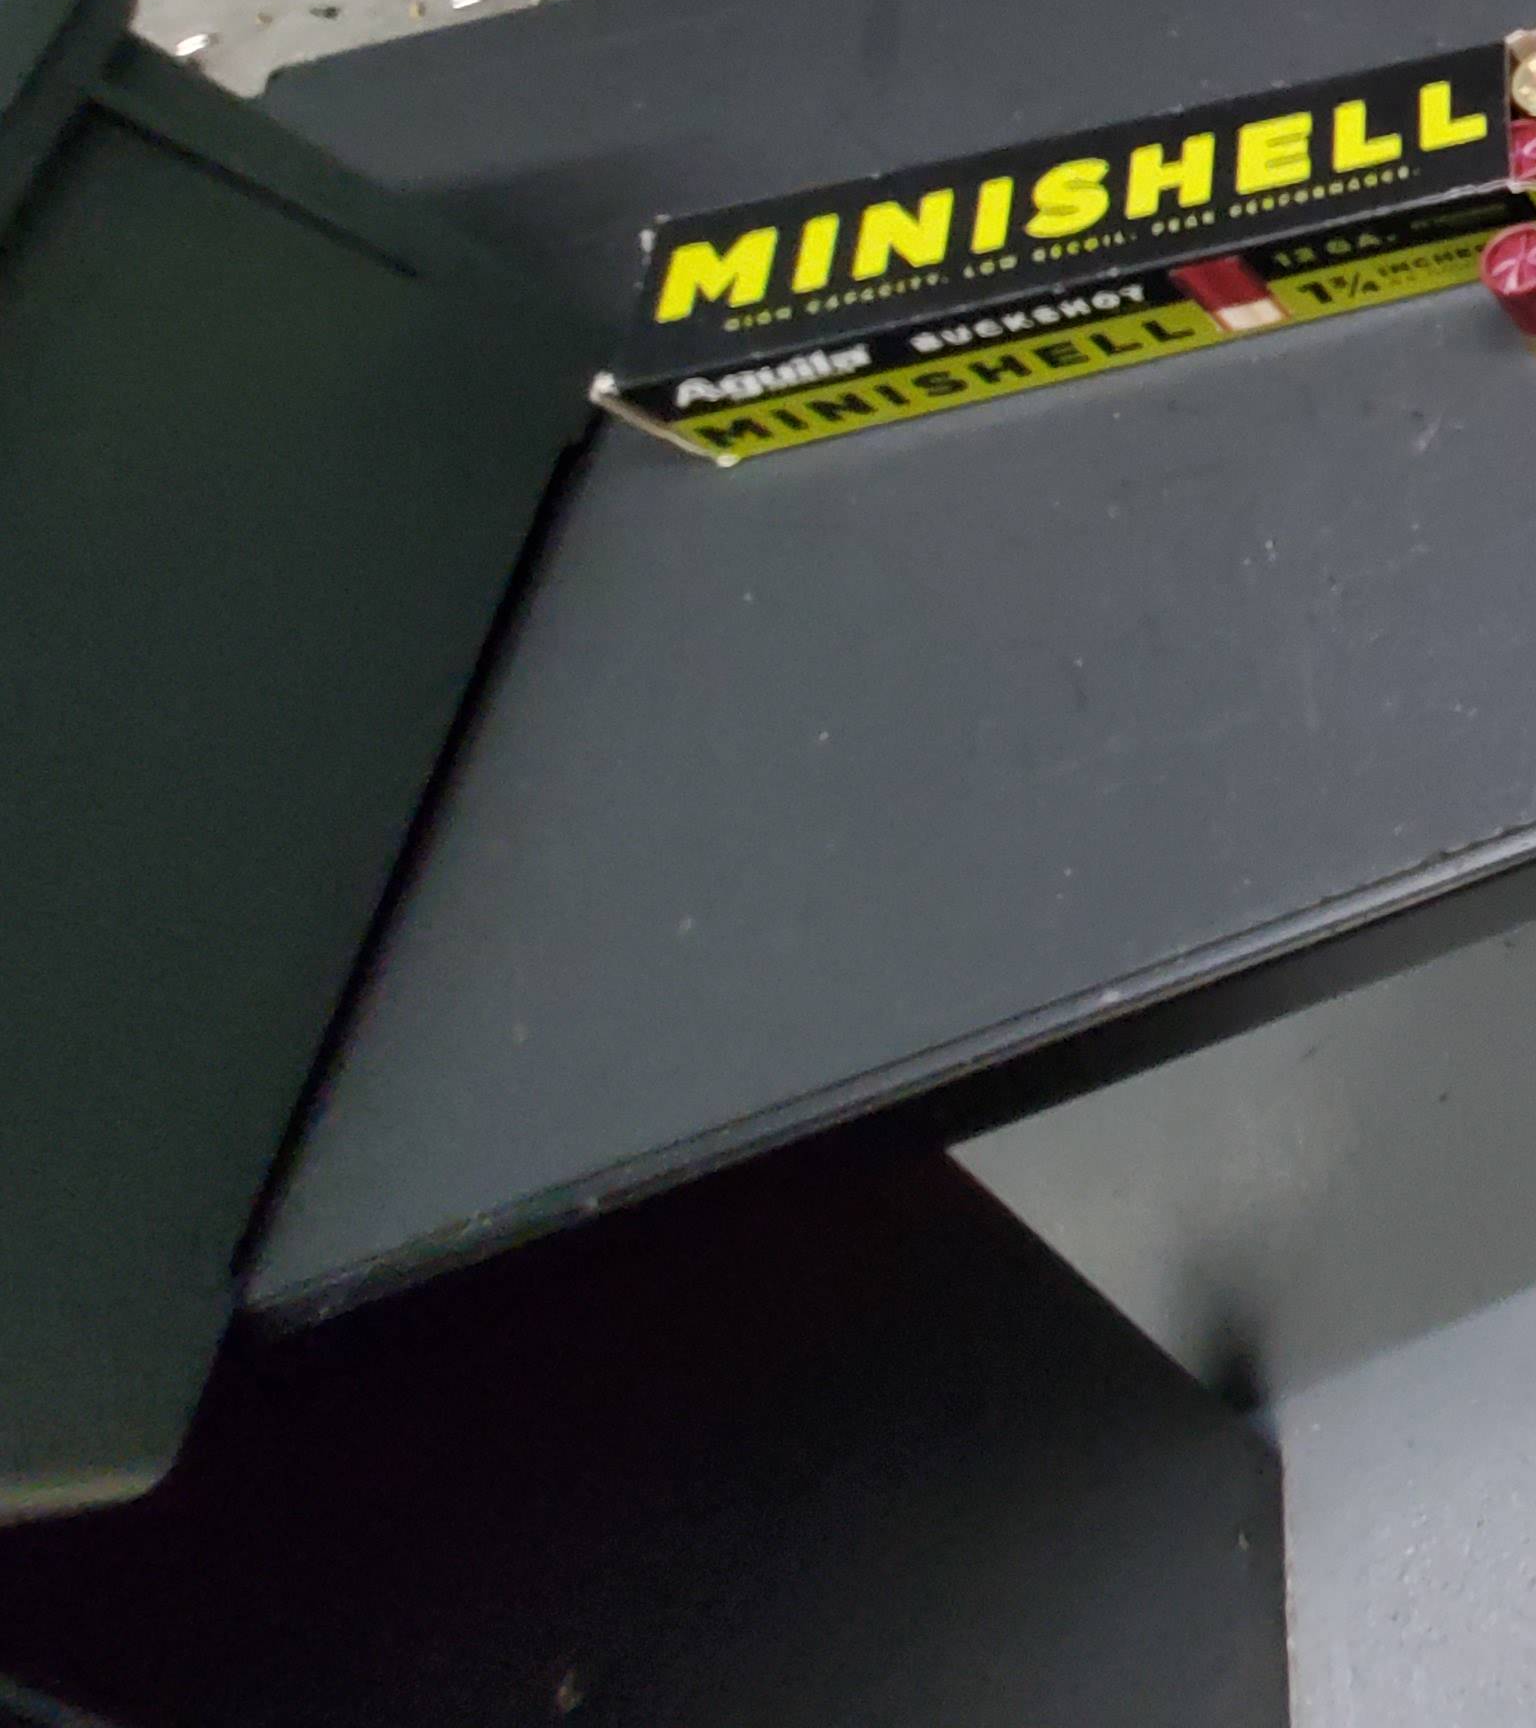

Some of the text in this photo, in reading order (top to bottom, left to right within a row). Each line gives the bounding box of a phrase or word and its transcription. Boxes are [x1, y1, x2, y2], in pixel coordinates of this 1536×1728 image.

[655, 80, 1488, 323] MINISHELL
[675, 283, 1145, 409] Aguila BUCKSHOT
[693, 318, 1196, 449] MINISHELL
